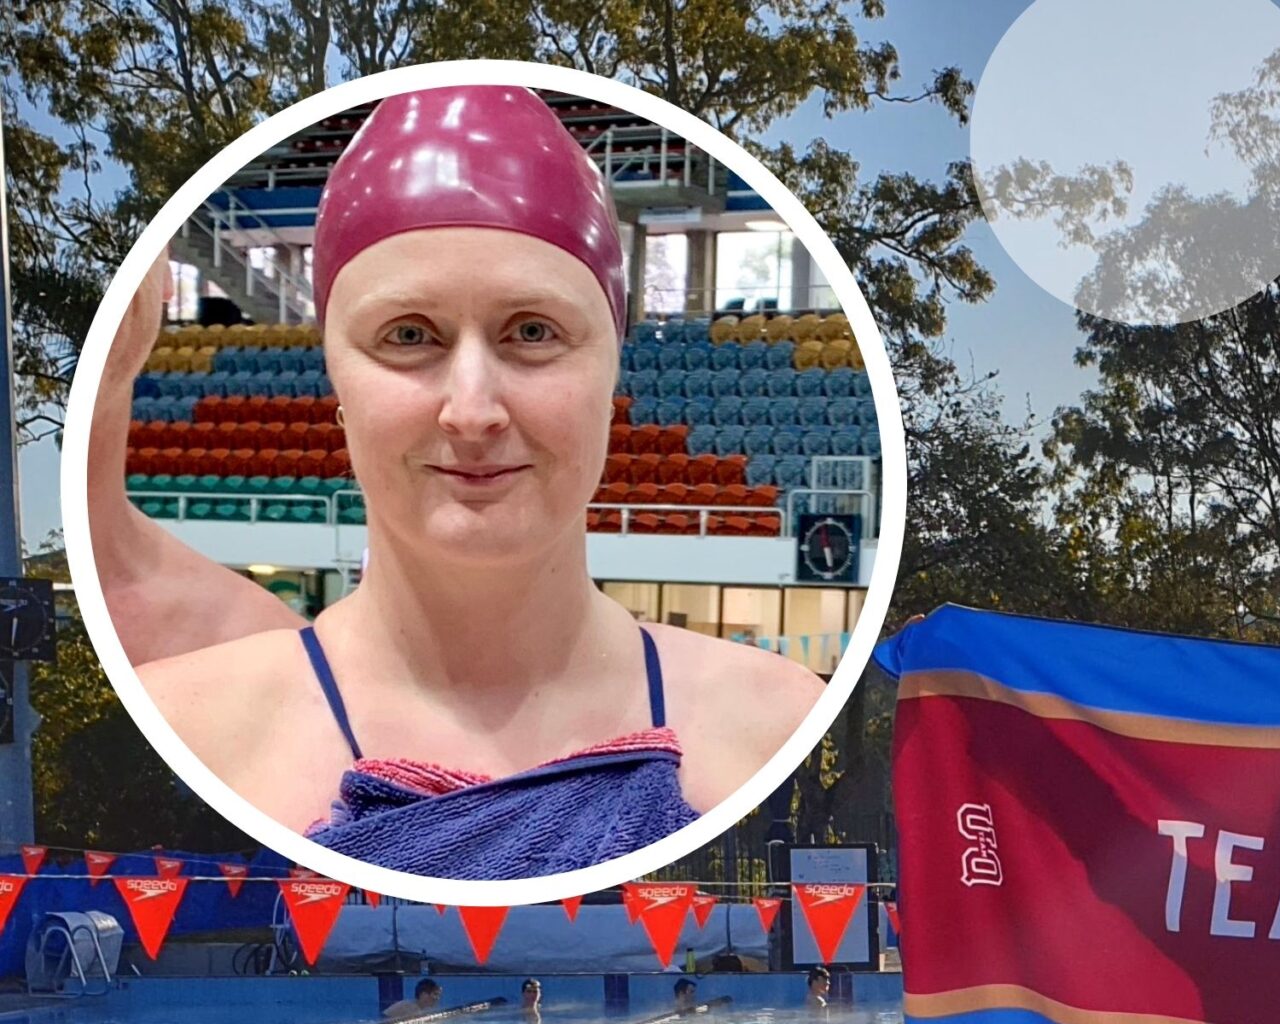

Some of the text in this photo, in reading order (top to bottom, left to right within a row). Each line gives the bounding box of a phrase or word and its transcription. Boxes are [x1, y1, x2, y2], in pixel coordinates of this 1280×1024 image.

[126, 878, 178, 892] speedo
[290, 882, 342, 896] speedo
[638, 885, 688, 899] speedo
[804, 884, 855, 897] speedo
